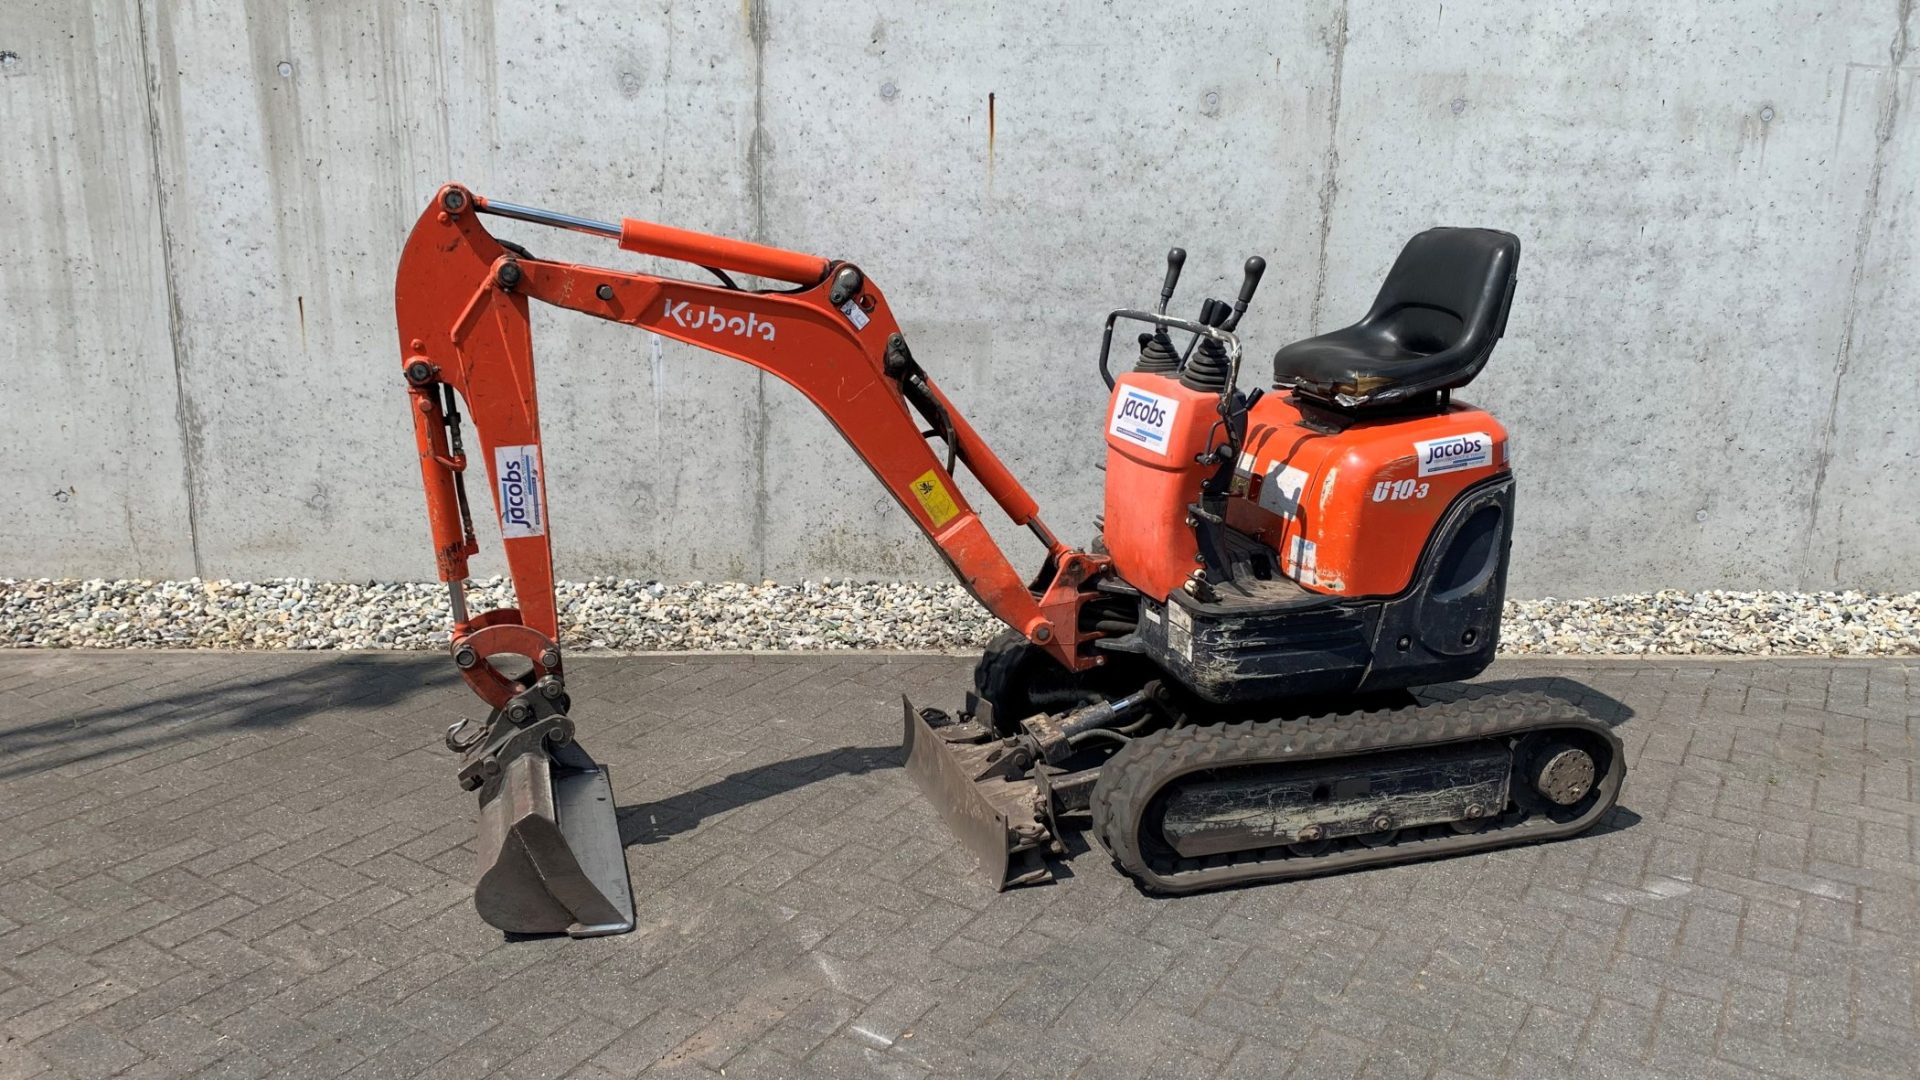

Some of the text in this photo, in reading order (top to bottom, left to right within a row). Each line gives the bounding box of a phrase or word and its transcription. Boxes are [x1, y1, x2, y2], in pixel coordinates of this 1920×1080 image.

[664, 298, 776, 341] Kubota
[1117, 397, 1166, 428] jacobs
[1425, 437, 1482, 464] jacobs
[501, 461, 531, 529] jacobs
[1372, 478, 1430, 503] U10-3
